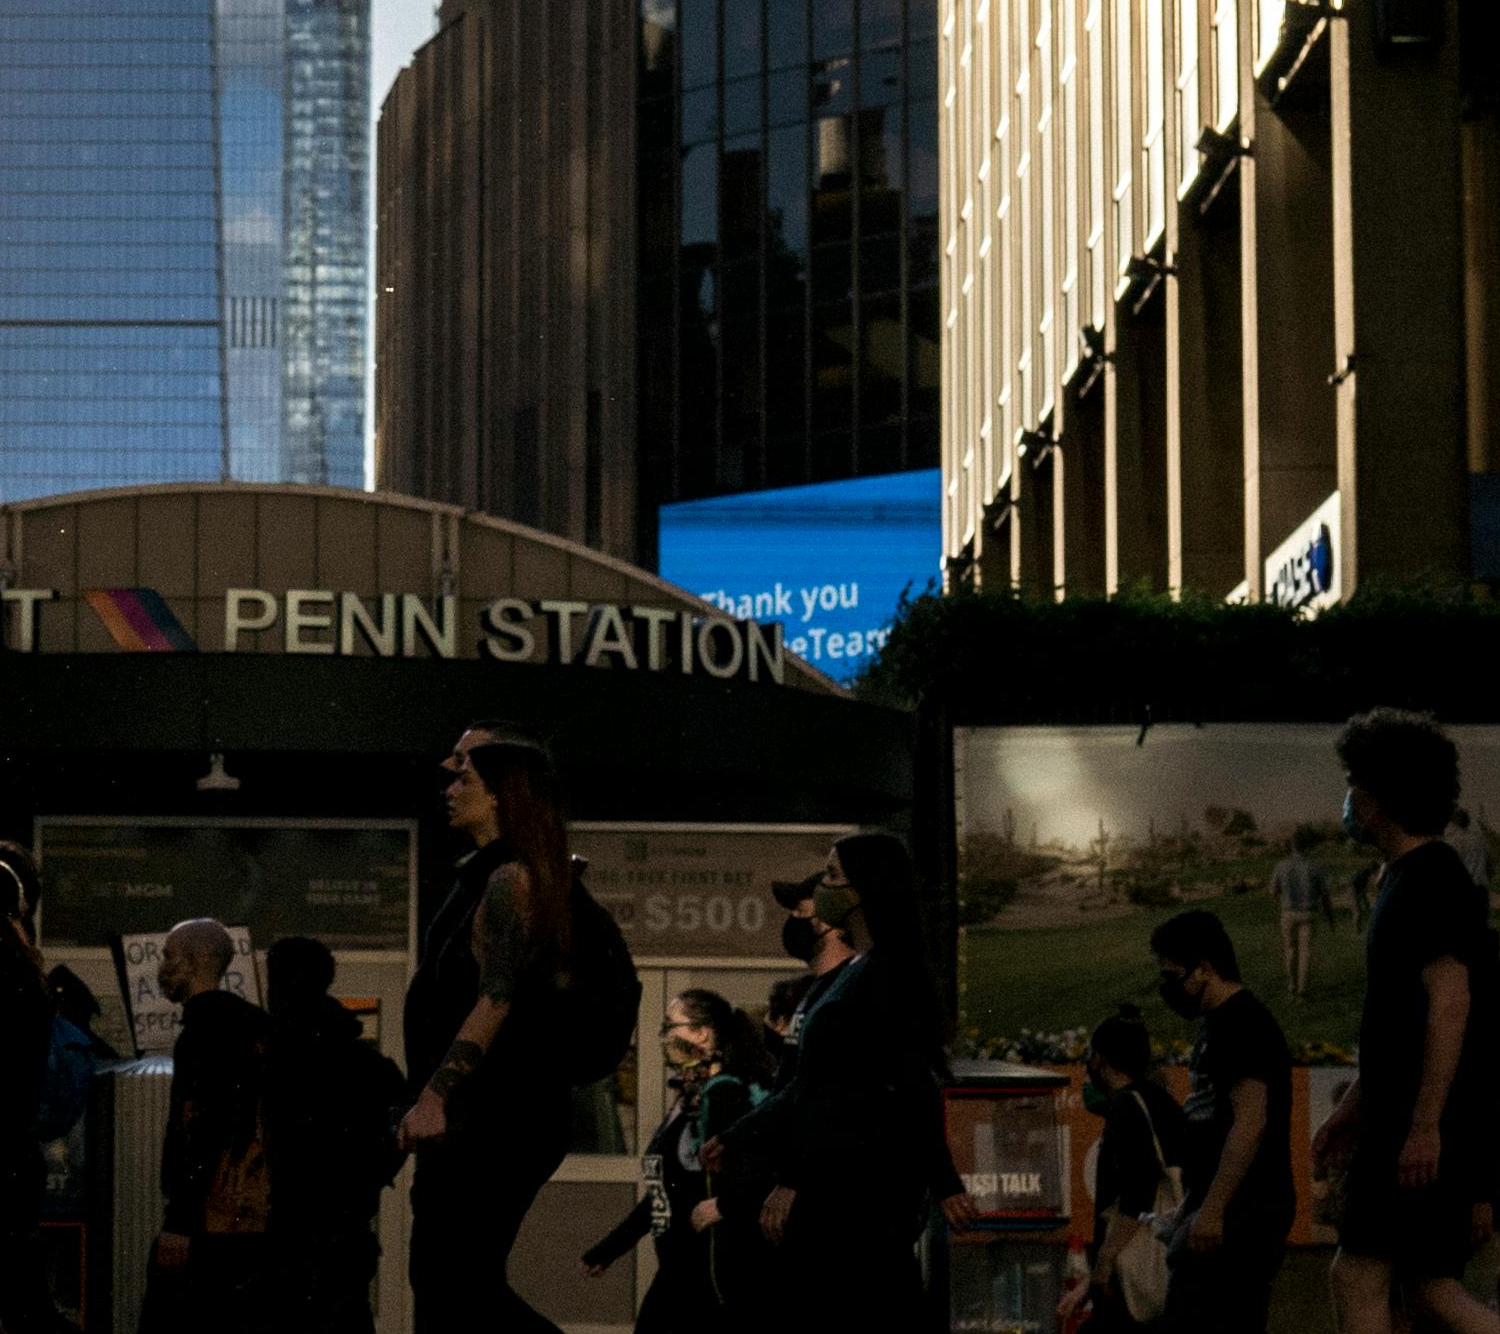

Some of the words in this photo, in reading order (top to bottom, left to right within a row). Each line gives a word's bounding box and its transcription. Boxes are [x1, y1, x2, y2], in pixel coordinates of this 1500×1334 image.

[800, 581, 859, 623] you
[225, 588, 456, 659] PENN
[487, 598, 785, 685] STATION
[645, 892, 766, 933] $500
